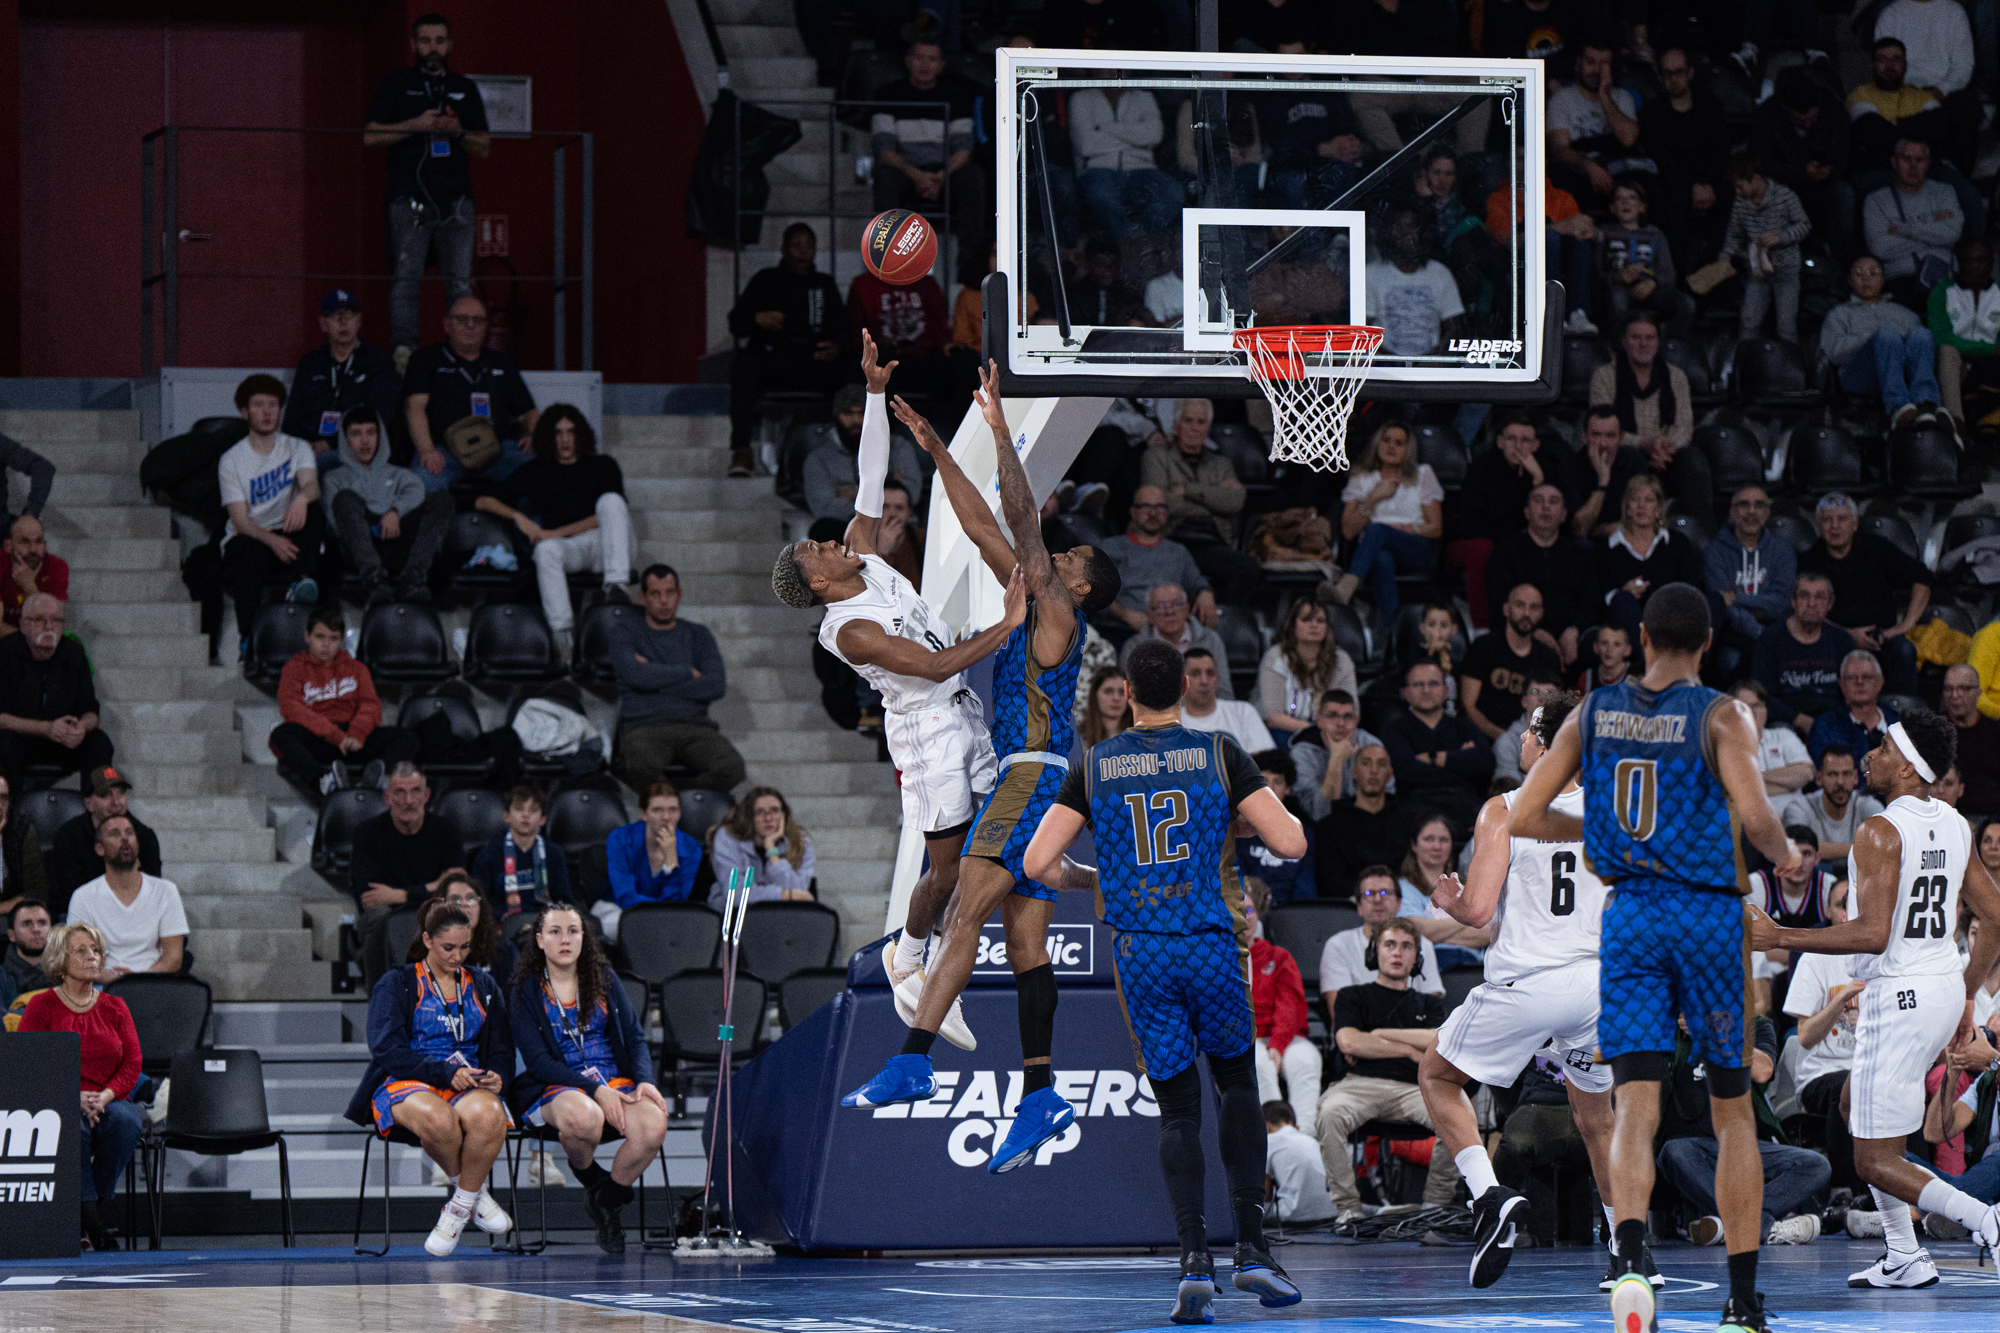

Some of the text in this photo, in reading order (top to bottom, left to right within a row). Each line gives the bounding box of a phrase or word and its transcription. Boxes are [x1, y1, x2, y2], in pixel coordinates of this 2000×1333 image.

[893, 219, 920, 255] LEGACY
[1448, 339, 1523, 353] LEADERS
[1466, 351, 1500, 364] CUP
[1100, 748, 1206, 781] DOSSOU-YOVO
[1613, 758, 1658, 842] 0
[1124, 789, 1190, 866] 12
[1920, 849, 1946, 870] SIMON
[1550, 851, 1576, 916] 6
[1903, 875, 1948, 939] 23
[975, 934, 1083, 965] Belic
[1119, 935, 1132, 957] 12
[1897, 989, 1917, 1011] 23
[872, 1070, 1162, 1118] EAERS
